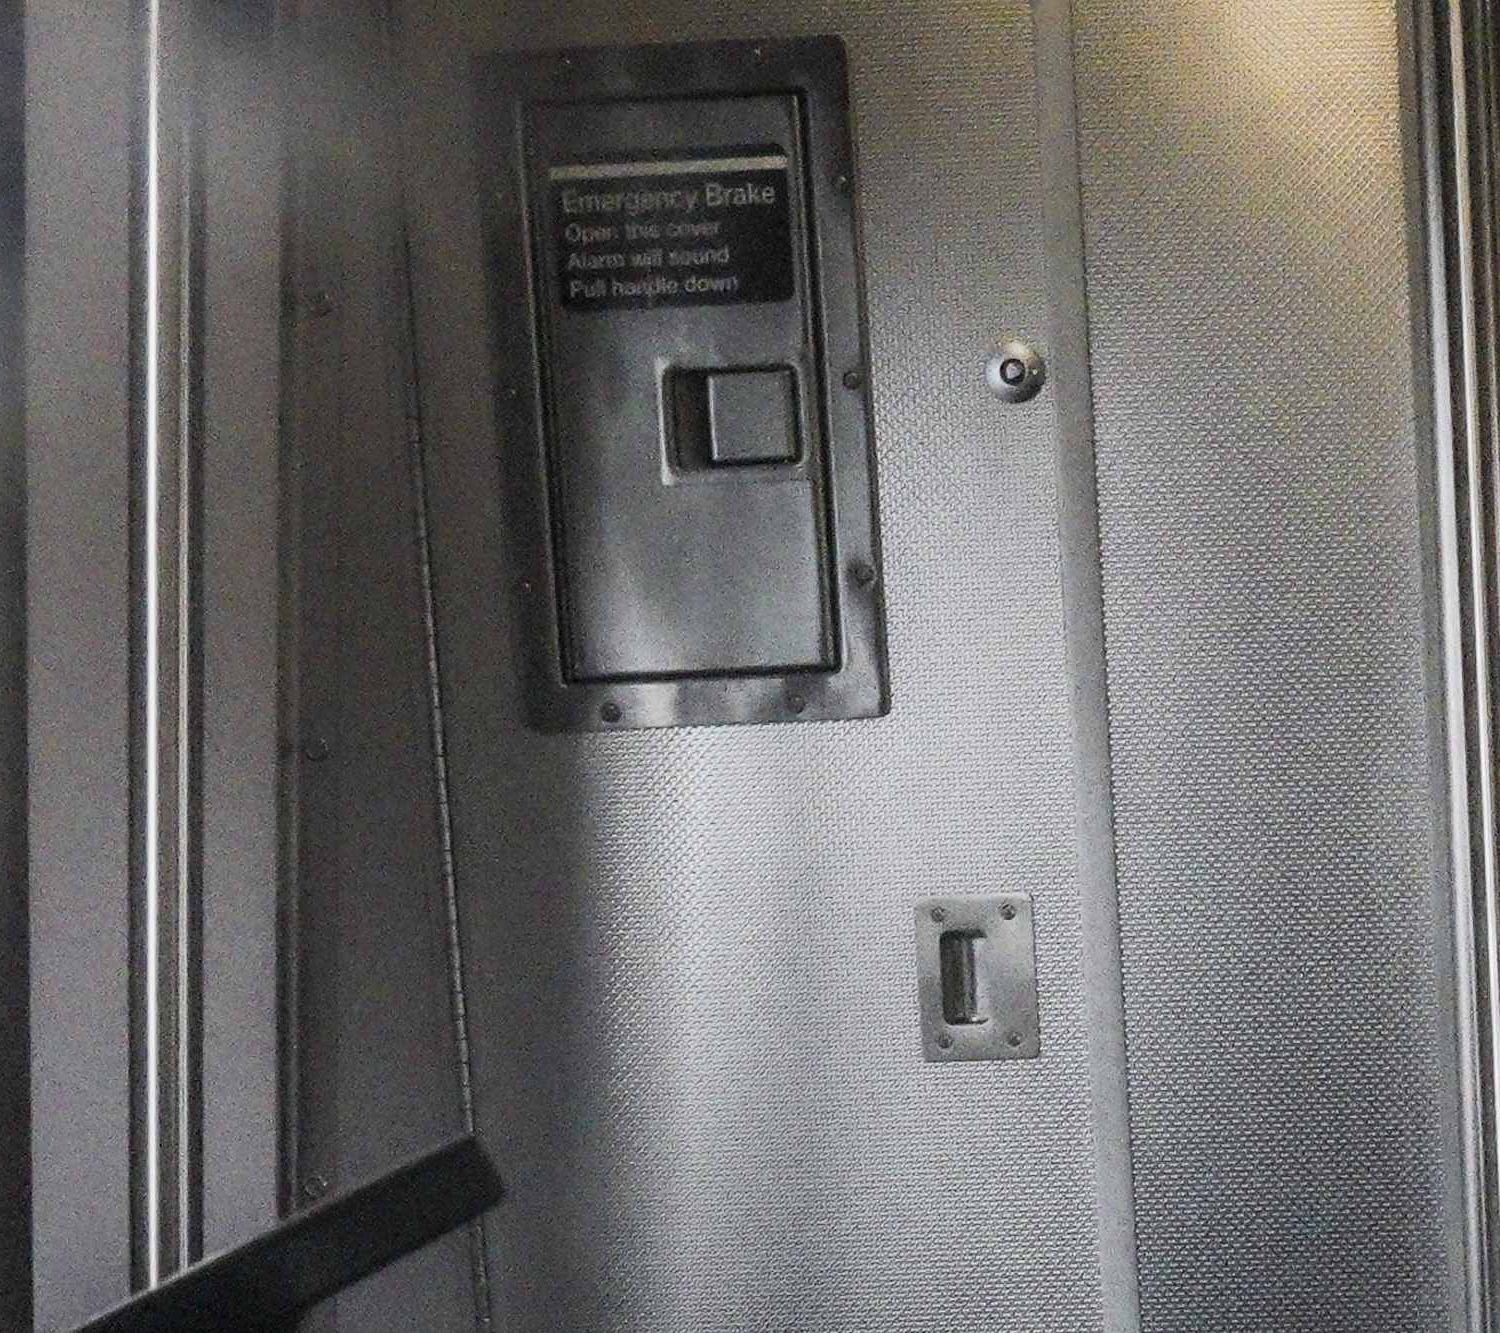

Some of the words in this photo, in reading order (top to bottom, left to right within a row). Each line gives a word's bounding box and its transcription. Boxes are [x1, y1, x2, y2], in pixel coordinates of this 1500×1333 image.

[562, 187, 697, 216] Emergency
[704, 182, 776, 207] Brake
[565, 222, 617, 246] Open
[568, 252, 625, 270] Alarm
[631, 249, 663, 267] will
[668, 246, 729, 266] sound
[570, 279, 607, 298] Pull
[612, 277, 679, 296] handle
[685, 275, 738, 294] down
